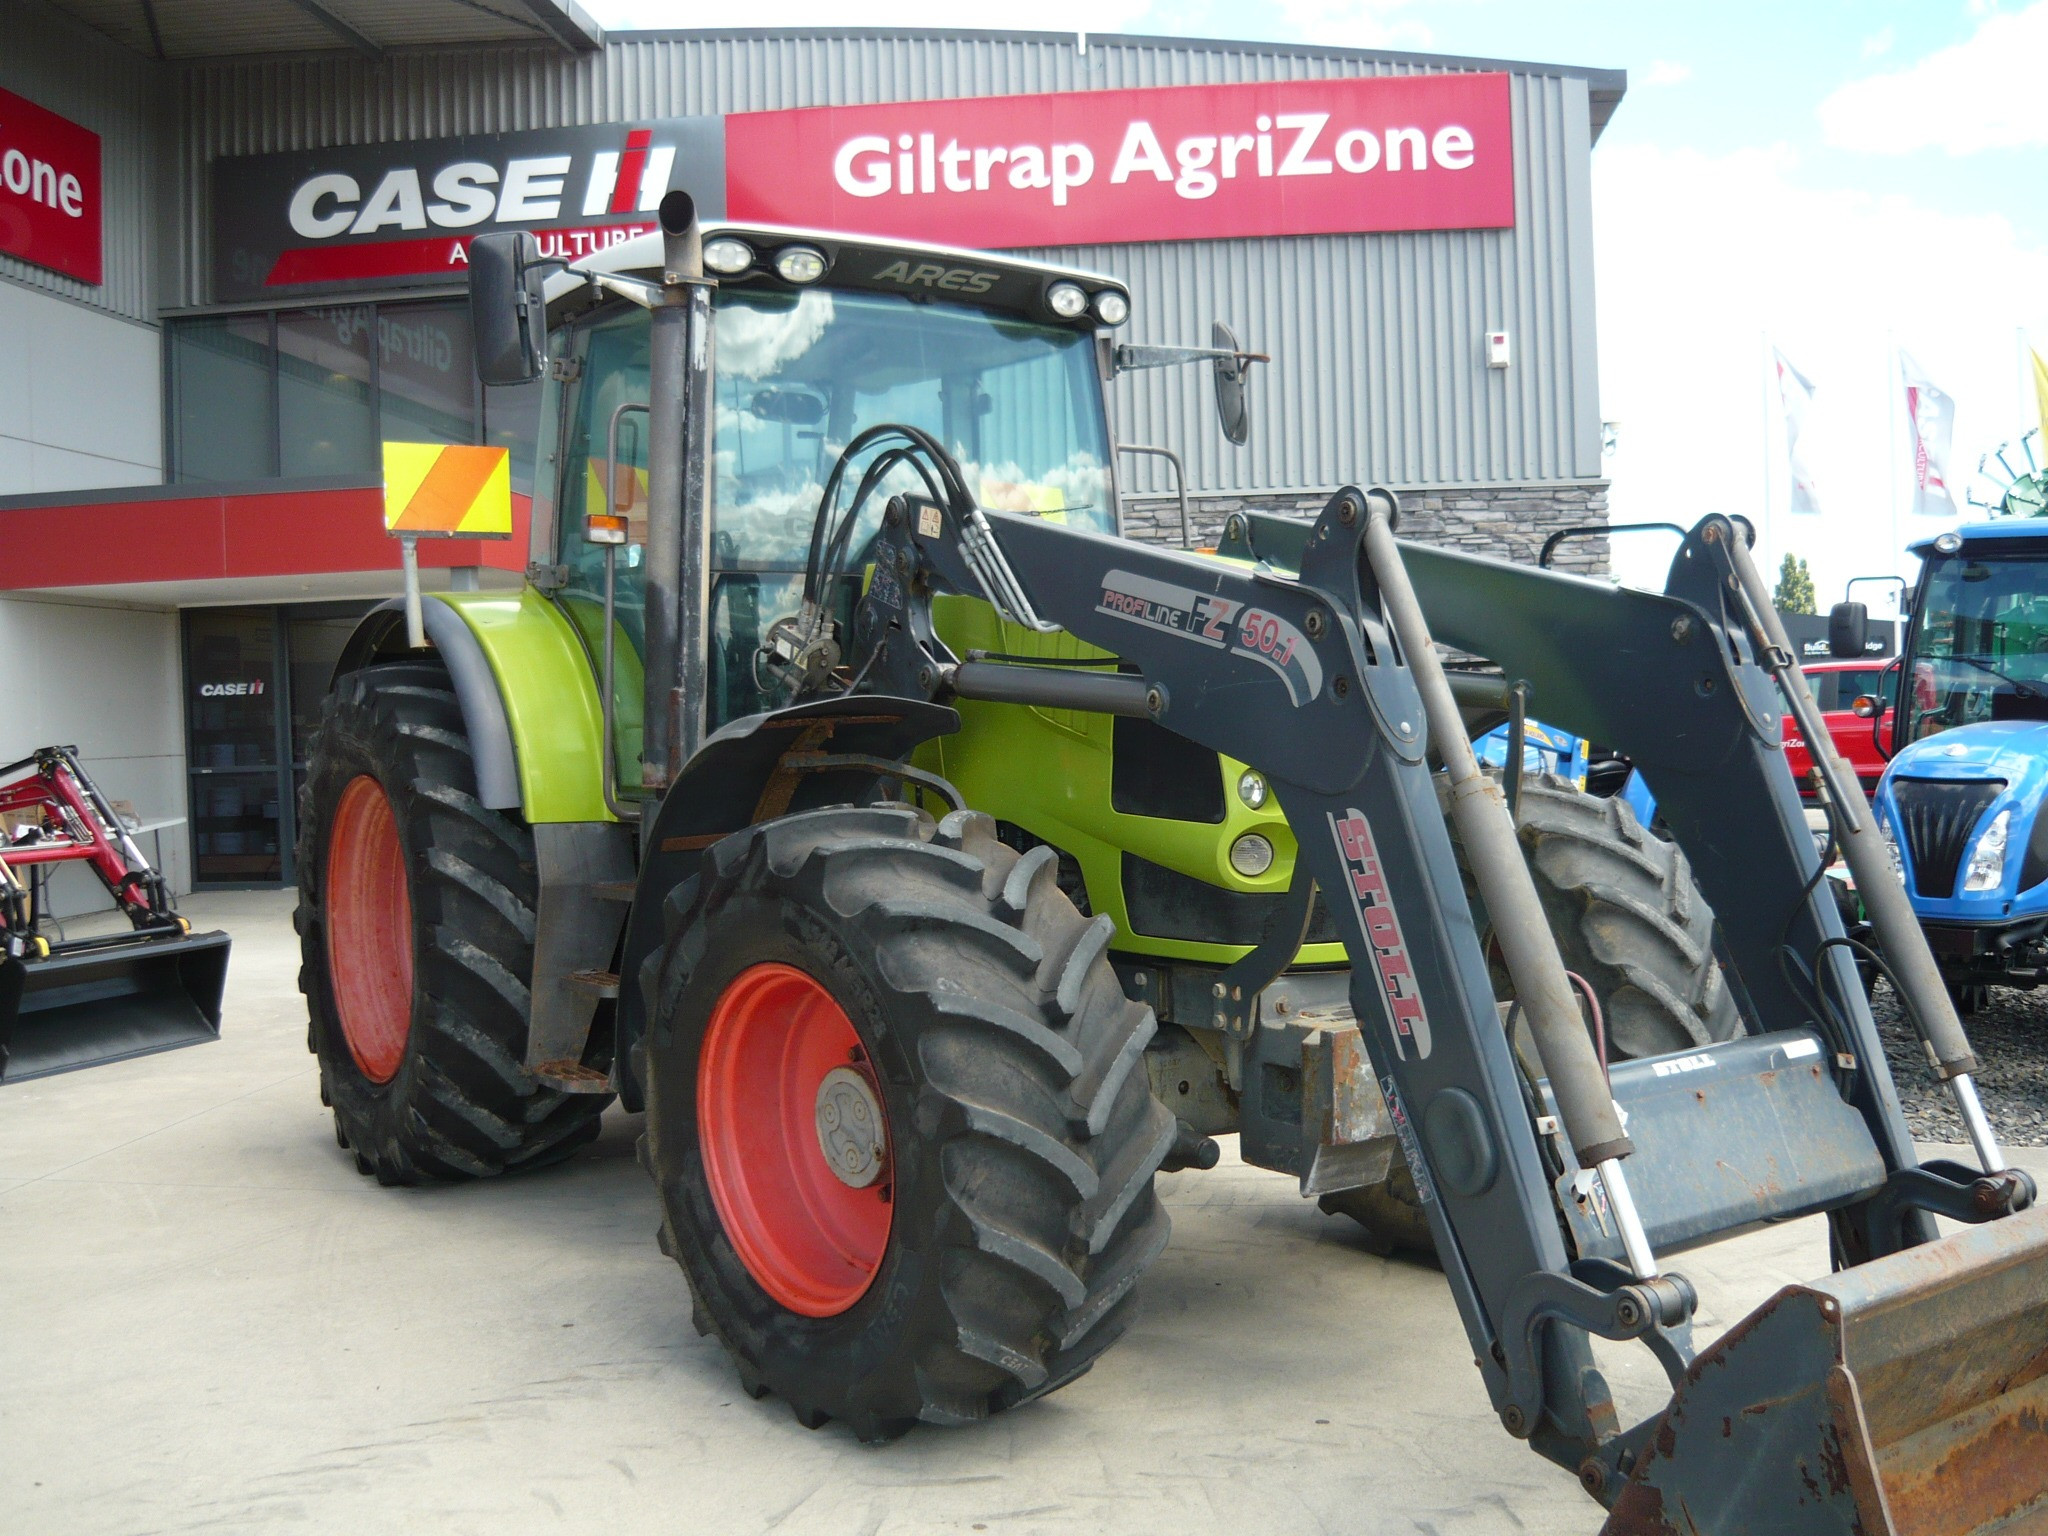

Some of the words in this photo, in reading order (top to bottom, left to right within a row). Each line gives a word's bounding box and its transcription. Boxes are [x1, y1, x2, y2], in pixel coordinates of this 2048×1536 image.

[0, 148, 83, 218] one
[834, 131, 1094, 206] Giltrap
[1110, 113, 1475, 200] AgriZone
[289, 156, 571, 239] CASE
[872, 260, 1001, 294] ARES
[1102, 590, 1181, 628] PROFILINE
[1186, 595, 1231, 641] FZ
[1241, 612, 1300, 667] 50.1
[201, 683, 248, 697] CASE
[1336, 817, 1424, 1036] STOLL
[1652, 1053, 1716, 1077] STOLL
